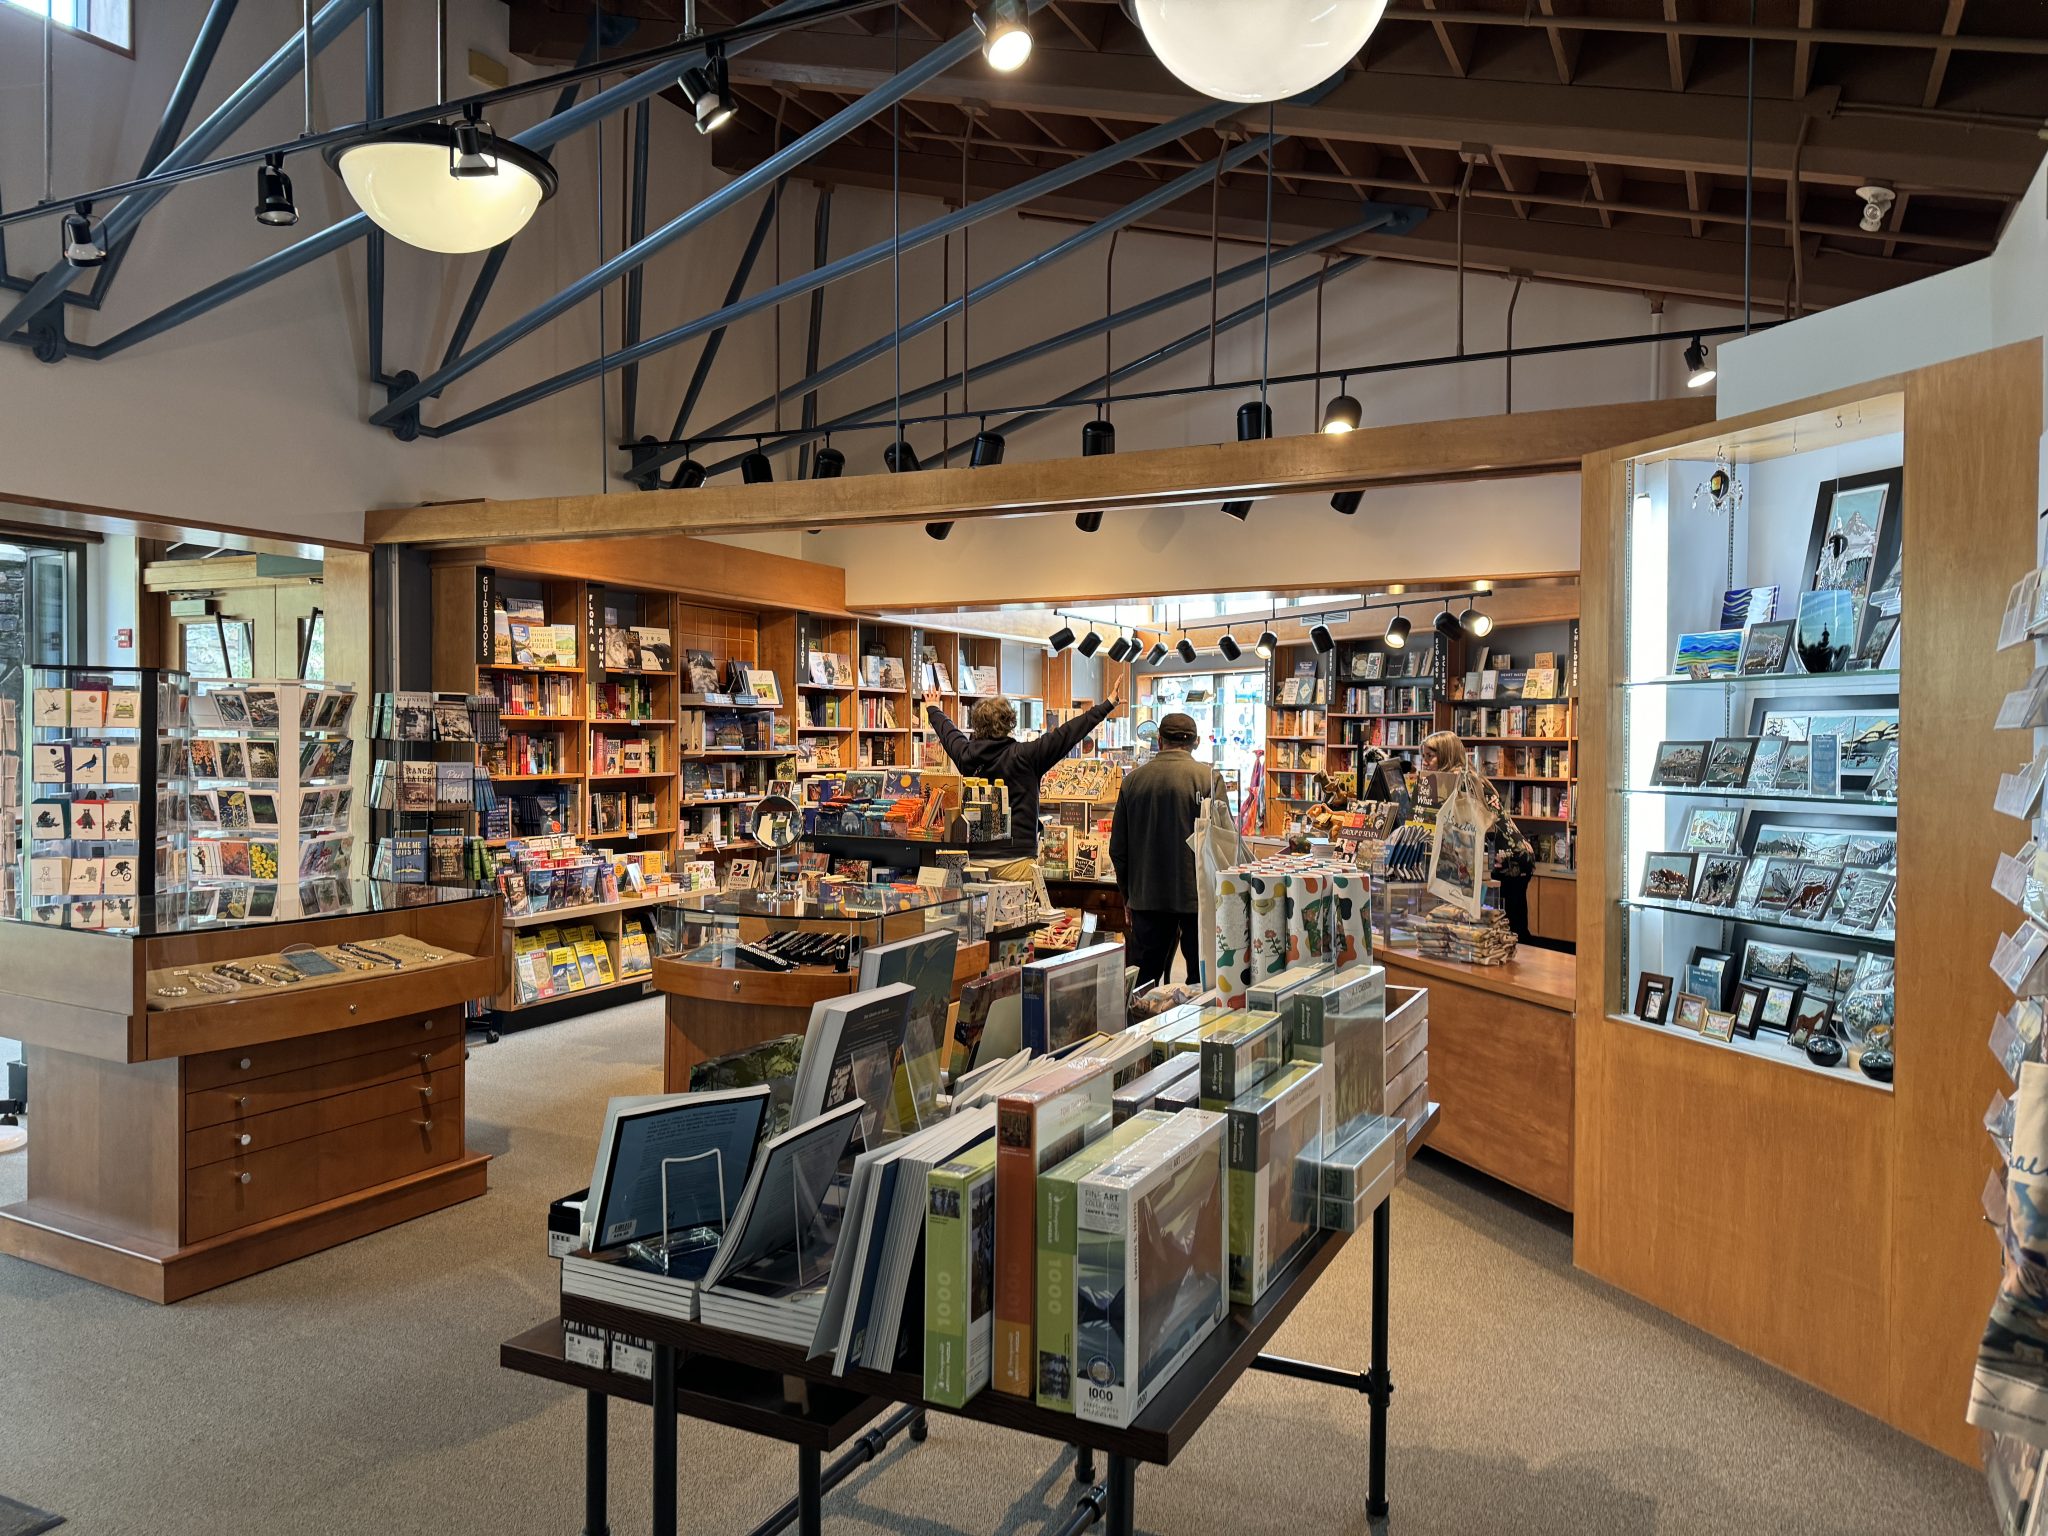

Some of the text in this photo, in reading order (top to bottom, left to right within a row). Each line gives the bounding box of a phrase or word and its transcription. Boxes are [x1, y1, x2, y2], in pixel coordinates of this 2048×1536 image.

[590, 643, 596, 652] &
[405, 767, 432, 775] RANCH
[1421, 776, 1429, 785] To
[1419, 786, 1430, 796] See
[1417, 795, 1433, 806] What
[1414, 806, 1424, 814] He
[395, 841, 411, 849] TAKE
[1103, 1192, 1119, 1203] ART
[1048, 1259, 1062, 1315] 1000
[937, 1271, 951, 1327] 1000
[1088, 1386, 1114, 1402] 1000
